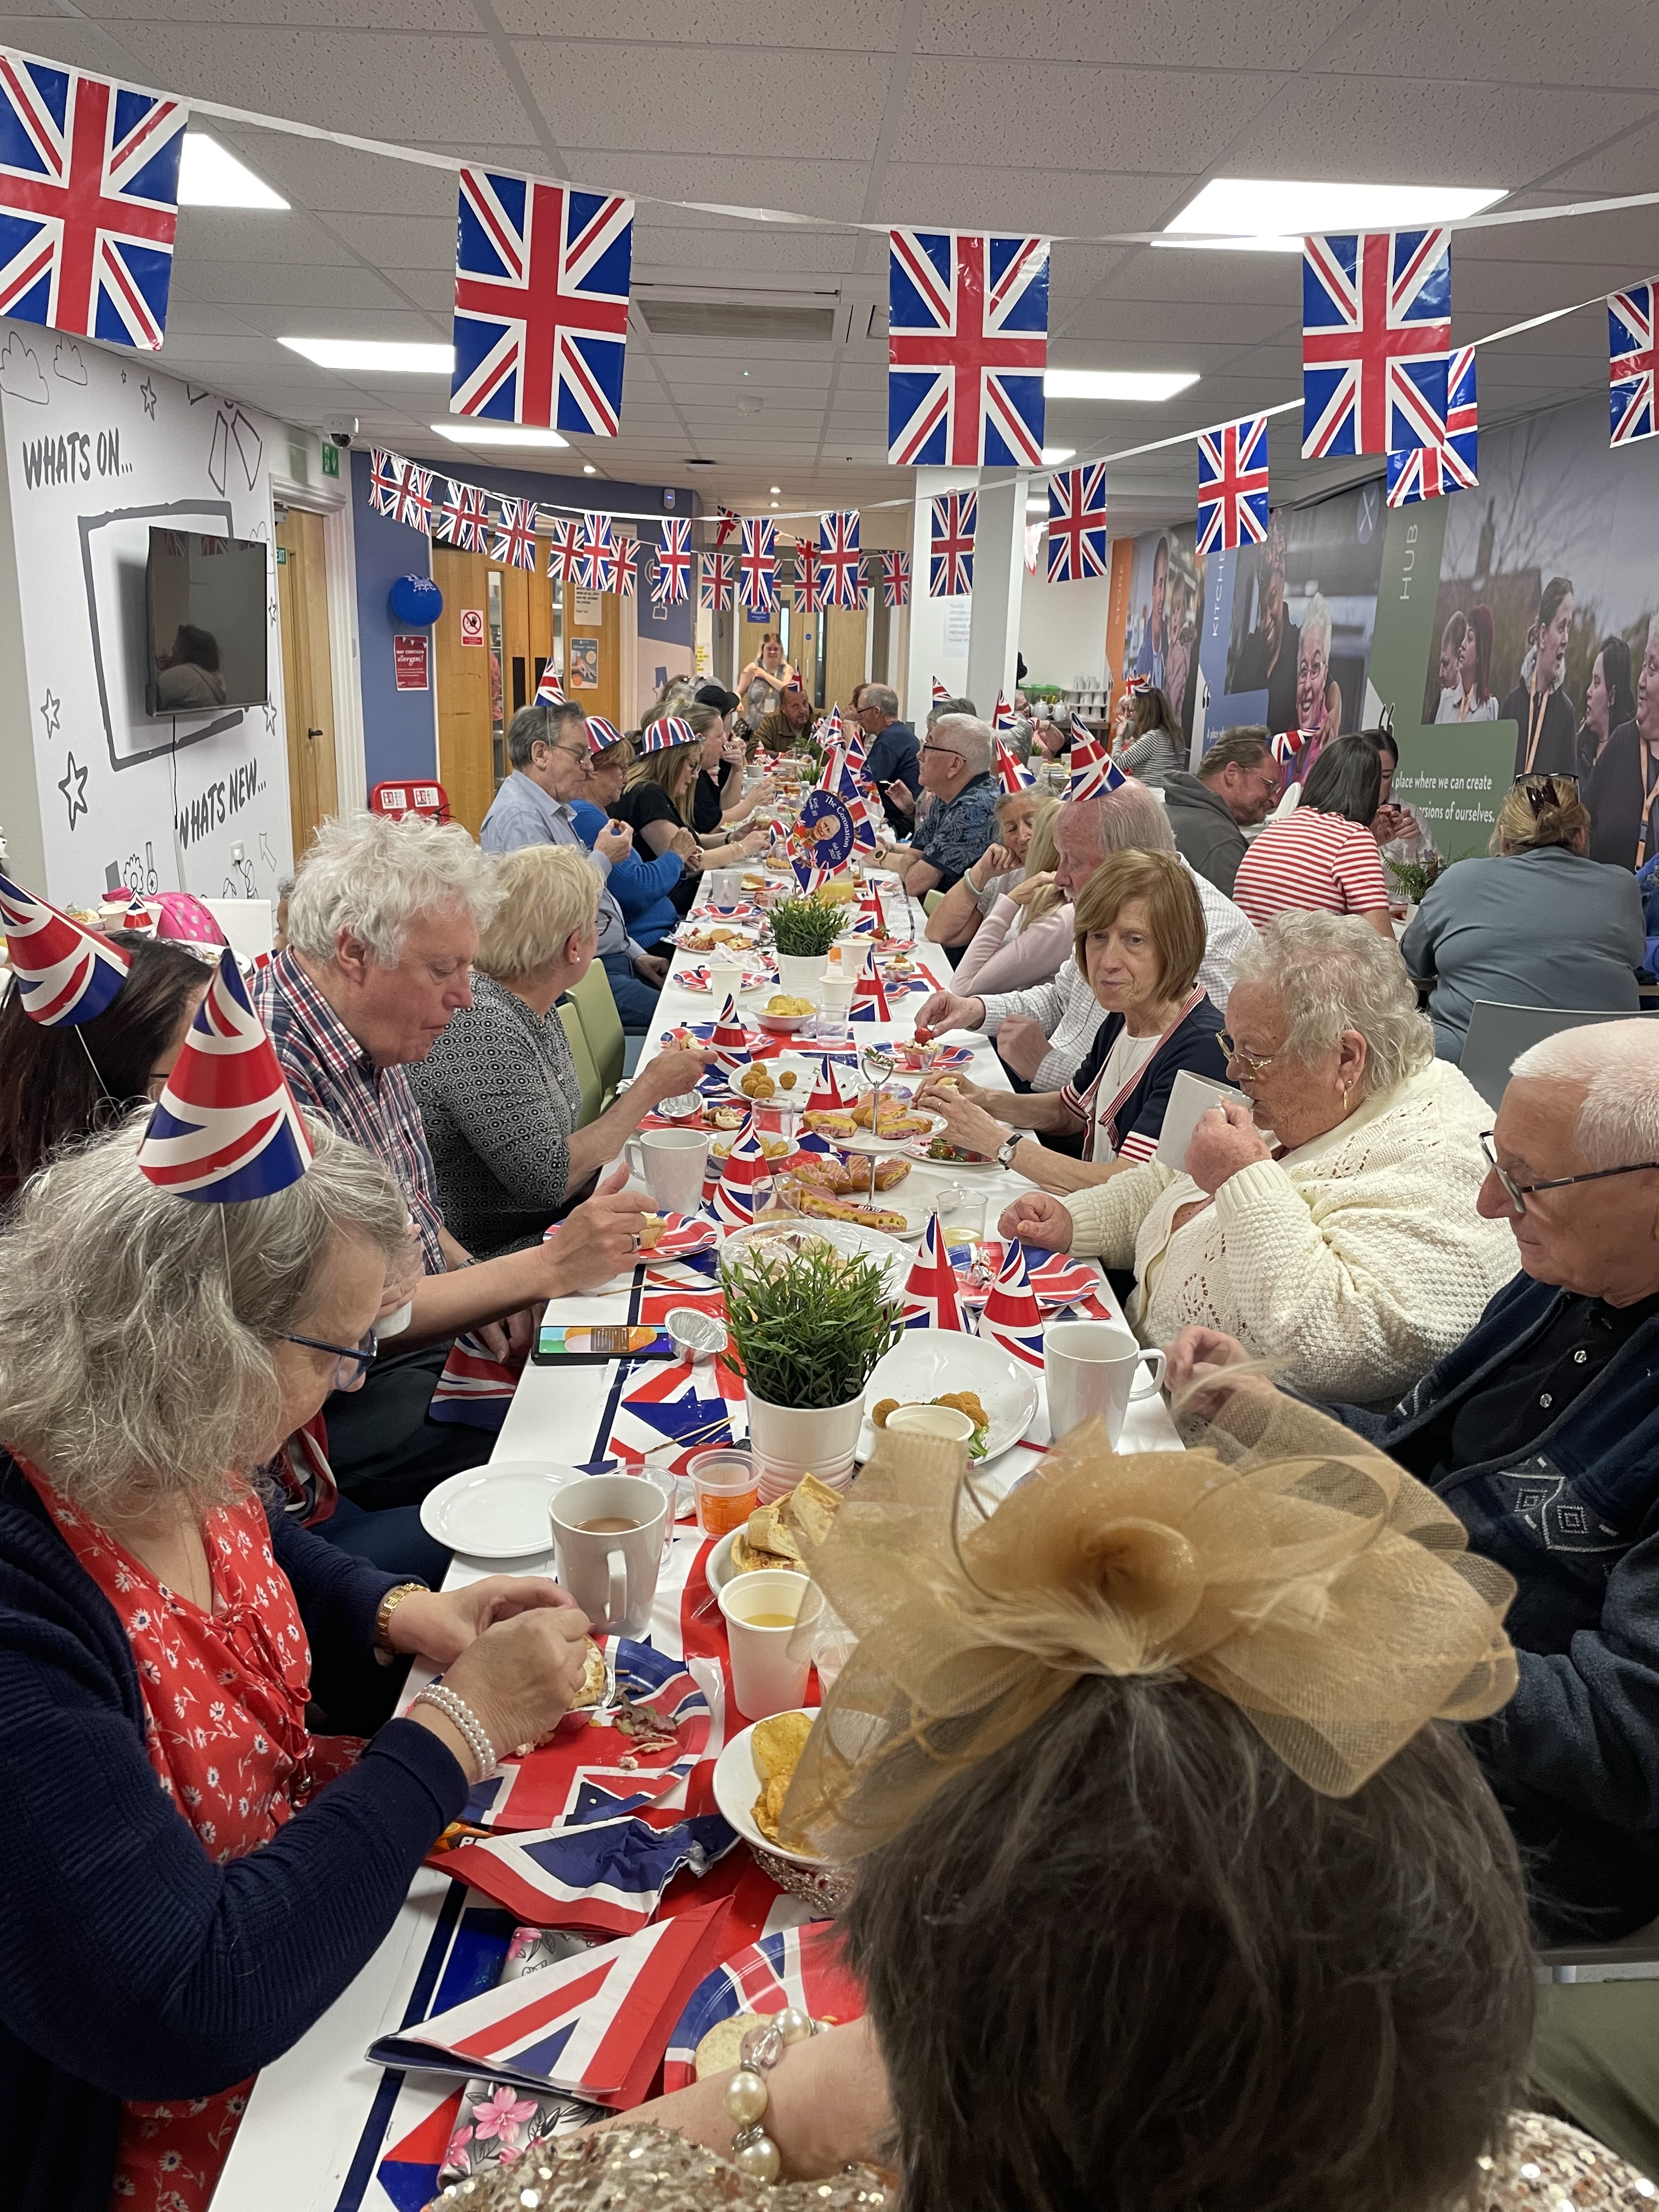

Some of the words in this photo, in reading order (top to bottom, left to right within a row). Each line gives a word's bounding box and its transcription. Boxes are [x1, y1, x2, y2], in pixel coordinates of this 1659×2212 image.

[22, 432, 91, 490] WHATS
[97, 427, 132, 477] ON...
[1400, 524, 1418, 600] HUB
[1212, 551, 1225, 636] KITCHE
[229, 758, 266, 815] NEW...
[1395, 771, 1413, 792] place
[1414, 770, 1437, 789] where
[1438, 777, 1449, 789] we
[1450, 777, 1464, 789] can
[1466, 775, 1492, 790] create
[825, 794, 837, 808] The
[837, 806, 851, 848] Coronation
[1419, 800, 1443, 819] rsions
[1444, 801, 1455, 820] of
[1455, 802, 1495, 823] ourselves.
